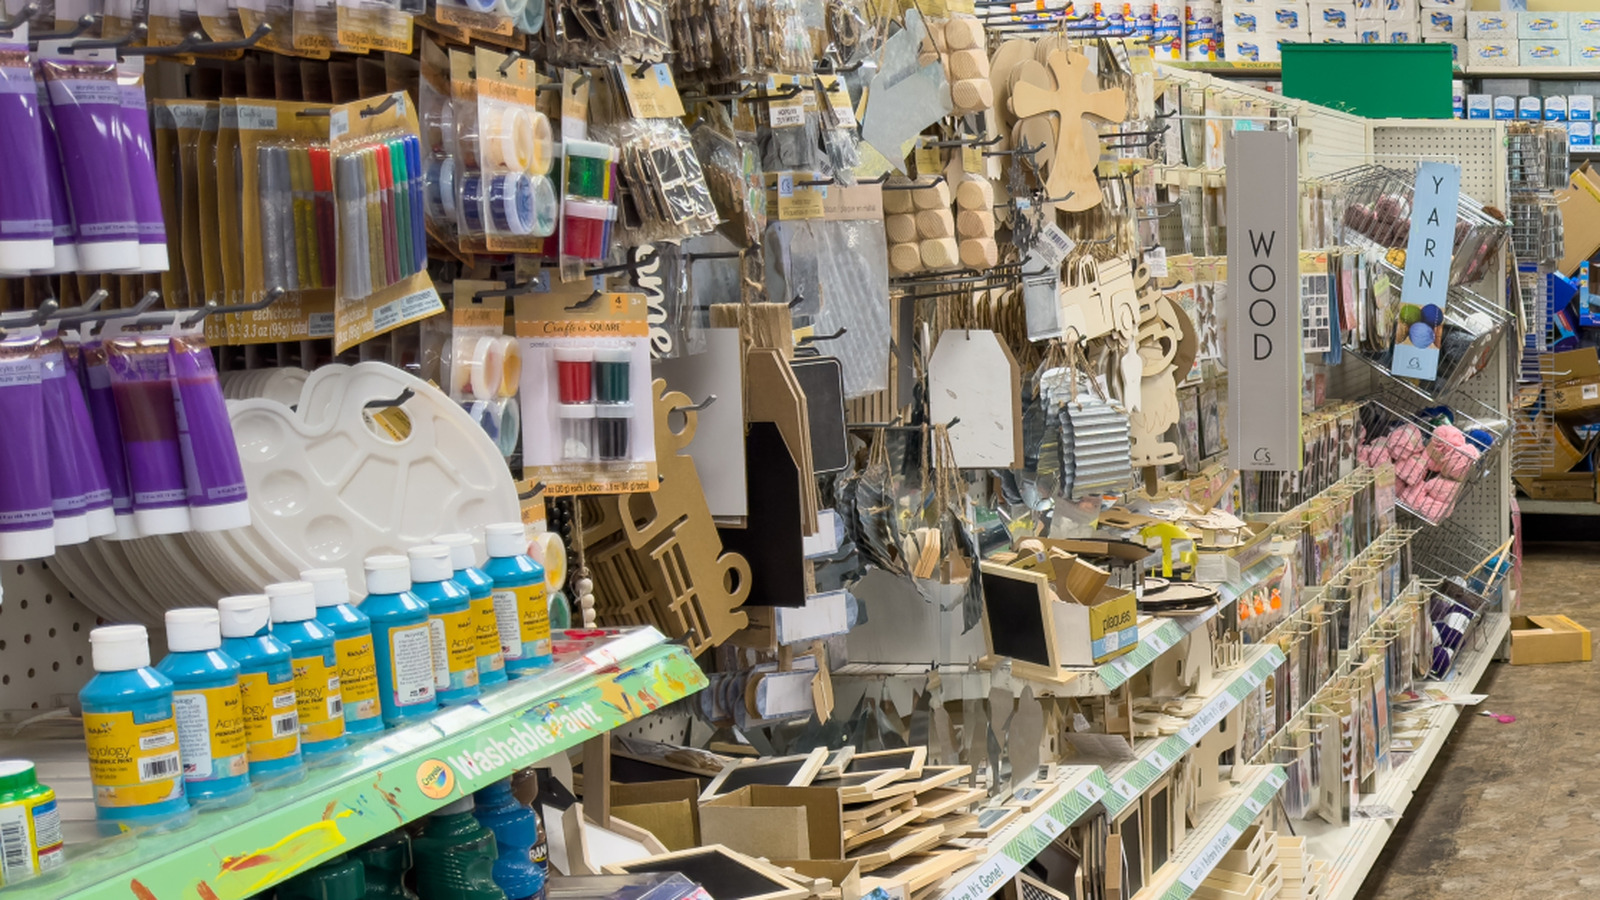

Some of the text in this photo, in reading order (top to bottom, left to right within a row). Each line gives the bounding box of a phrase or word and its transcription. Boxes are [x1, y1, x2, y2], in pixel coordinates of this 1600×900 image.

[1419, 175, 1444, 289] YARN
[615, 296, 622, 305] 4
[1248, 229, 1277, 361] WOOD
[243, 324, 257, 339] 3.3
[589, 323, 622, 332] SQUARE
[1103, 610, 1132, 635] plaques
[421, 701, 603, 786] Crayola Washable Paint
[967, 862, 1005, 898] It's Gone!
